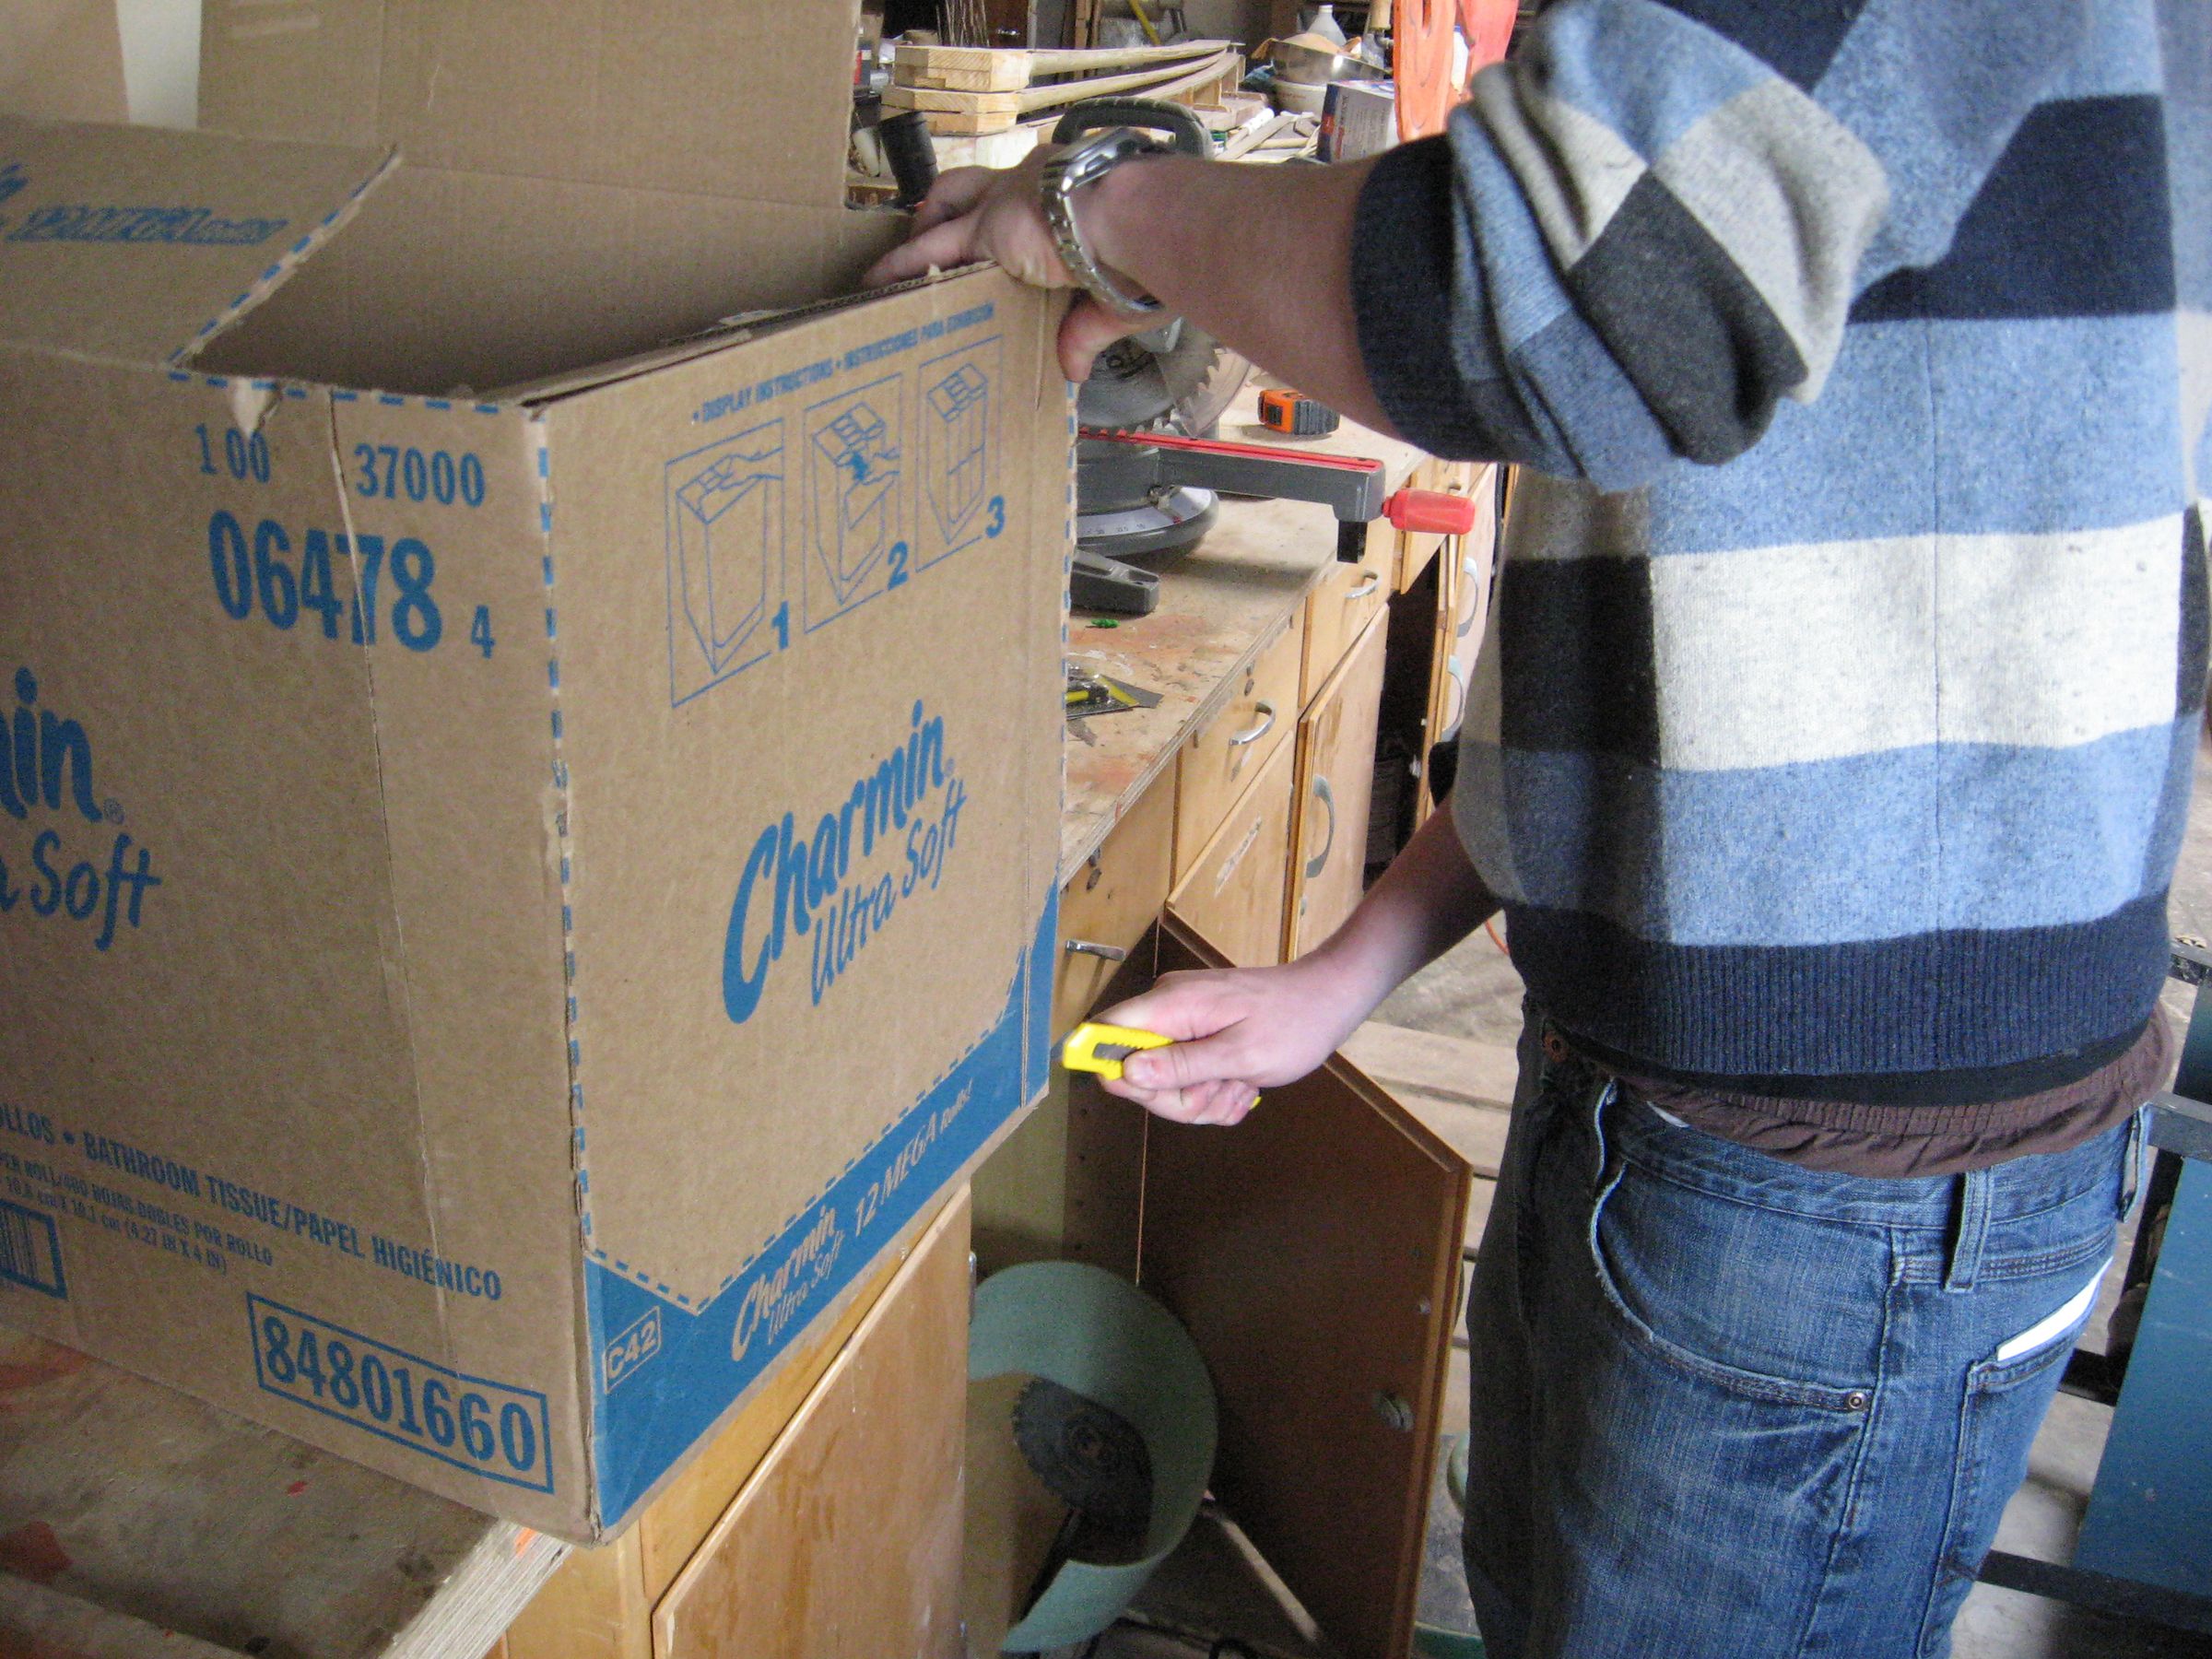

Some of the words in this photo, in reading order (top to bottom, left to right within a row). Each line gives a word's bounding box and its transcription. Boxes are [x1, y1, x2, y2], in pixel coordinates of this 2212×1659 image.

[354, 442, 487, 508] 37000
[985, 494, 1006, 539] 3
[208, 510, 442, 653] 06478
[471, 605, 497, 659] 4
[771, 600, 789, 652] 1
[887, 540, 910, 591] 2
[0, 666, 104, 823] in
[30, 830, 162, 952] Soft
[722, 699, 945, 1026] Charmin
[810, 871, 898, 1008] Ultra
[901, 778, 968, 899] Soft
[83, 1130, 201, 1198] BATHROOM
[205, 1174, 366, 1260] TISSUE/PAPEL
[371, 1235, 503, 1301] HIGIÉNICO
[855, 1182, 880, 1238] 12
[880, 1111, 937, 1206] MEGA
[227, 1233, 274, 1267] ROLLO
[731, 1204, 836, 1362] Charmin
[607, 1320, 657, 1380] C42
[768, 1281, 810, 1346] Ultra
[262, 1315, 536, 1473] 84801660
